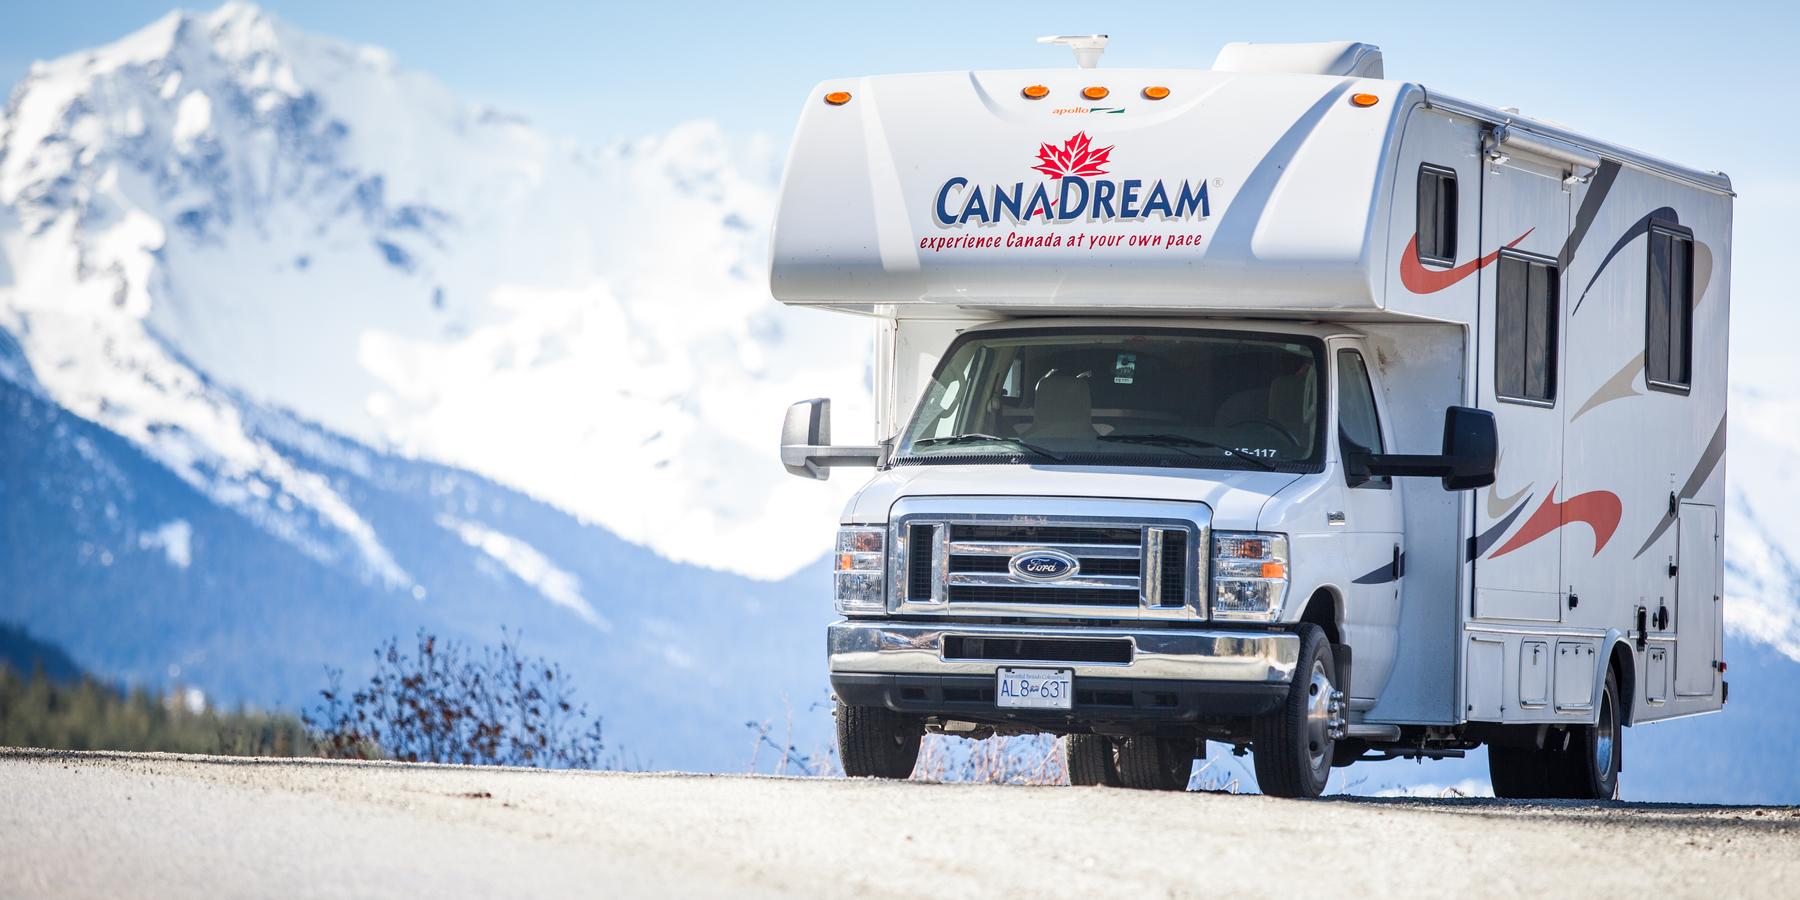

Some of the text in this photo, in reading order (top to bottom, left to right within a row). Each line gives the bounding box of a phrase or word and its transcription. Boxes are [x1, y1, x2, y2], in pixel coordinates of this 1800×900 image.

[1052, 106, 1089, 116] apollo
[920, 231, 1202, 252] experience Canada at your own pace
[1224, 447, 1277, 458] 85-117
[1027, 558, 1057, 572] Ford
